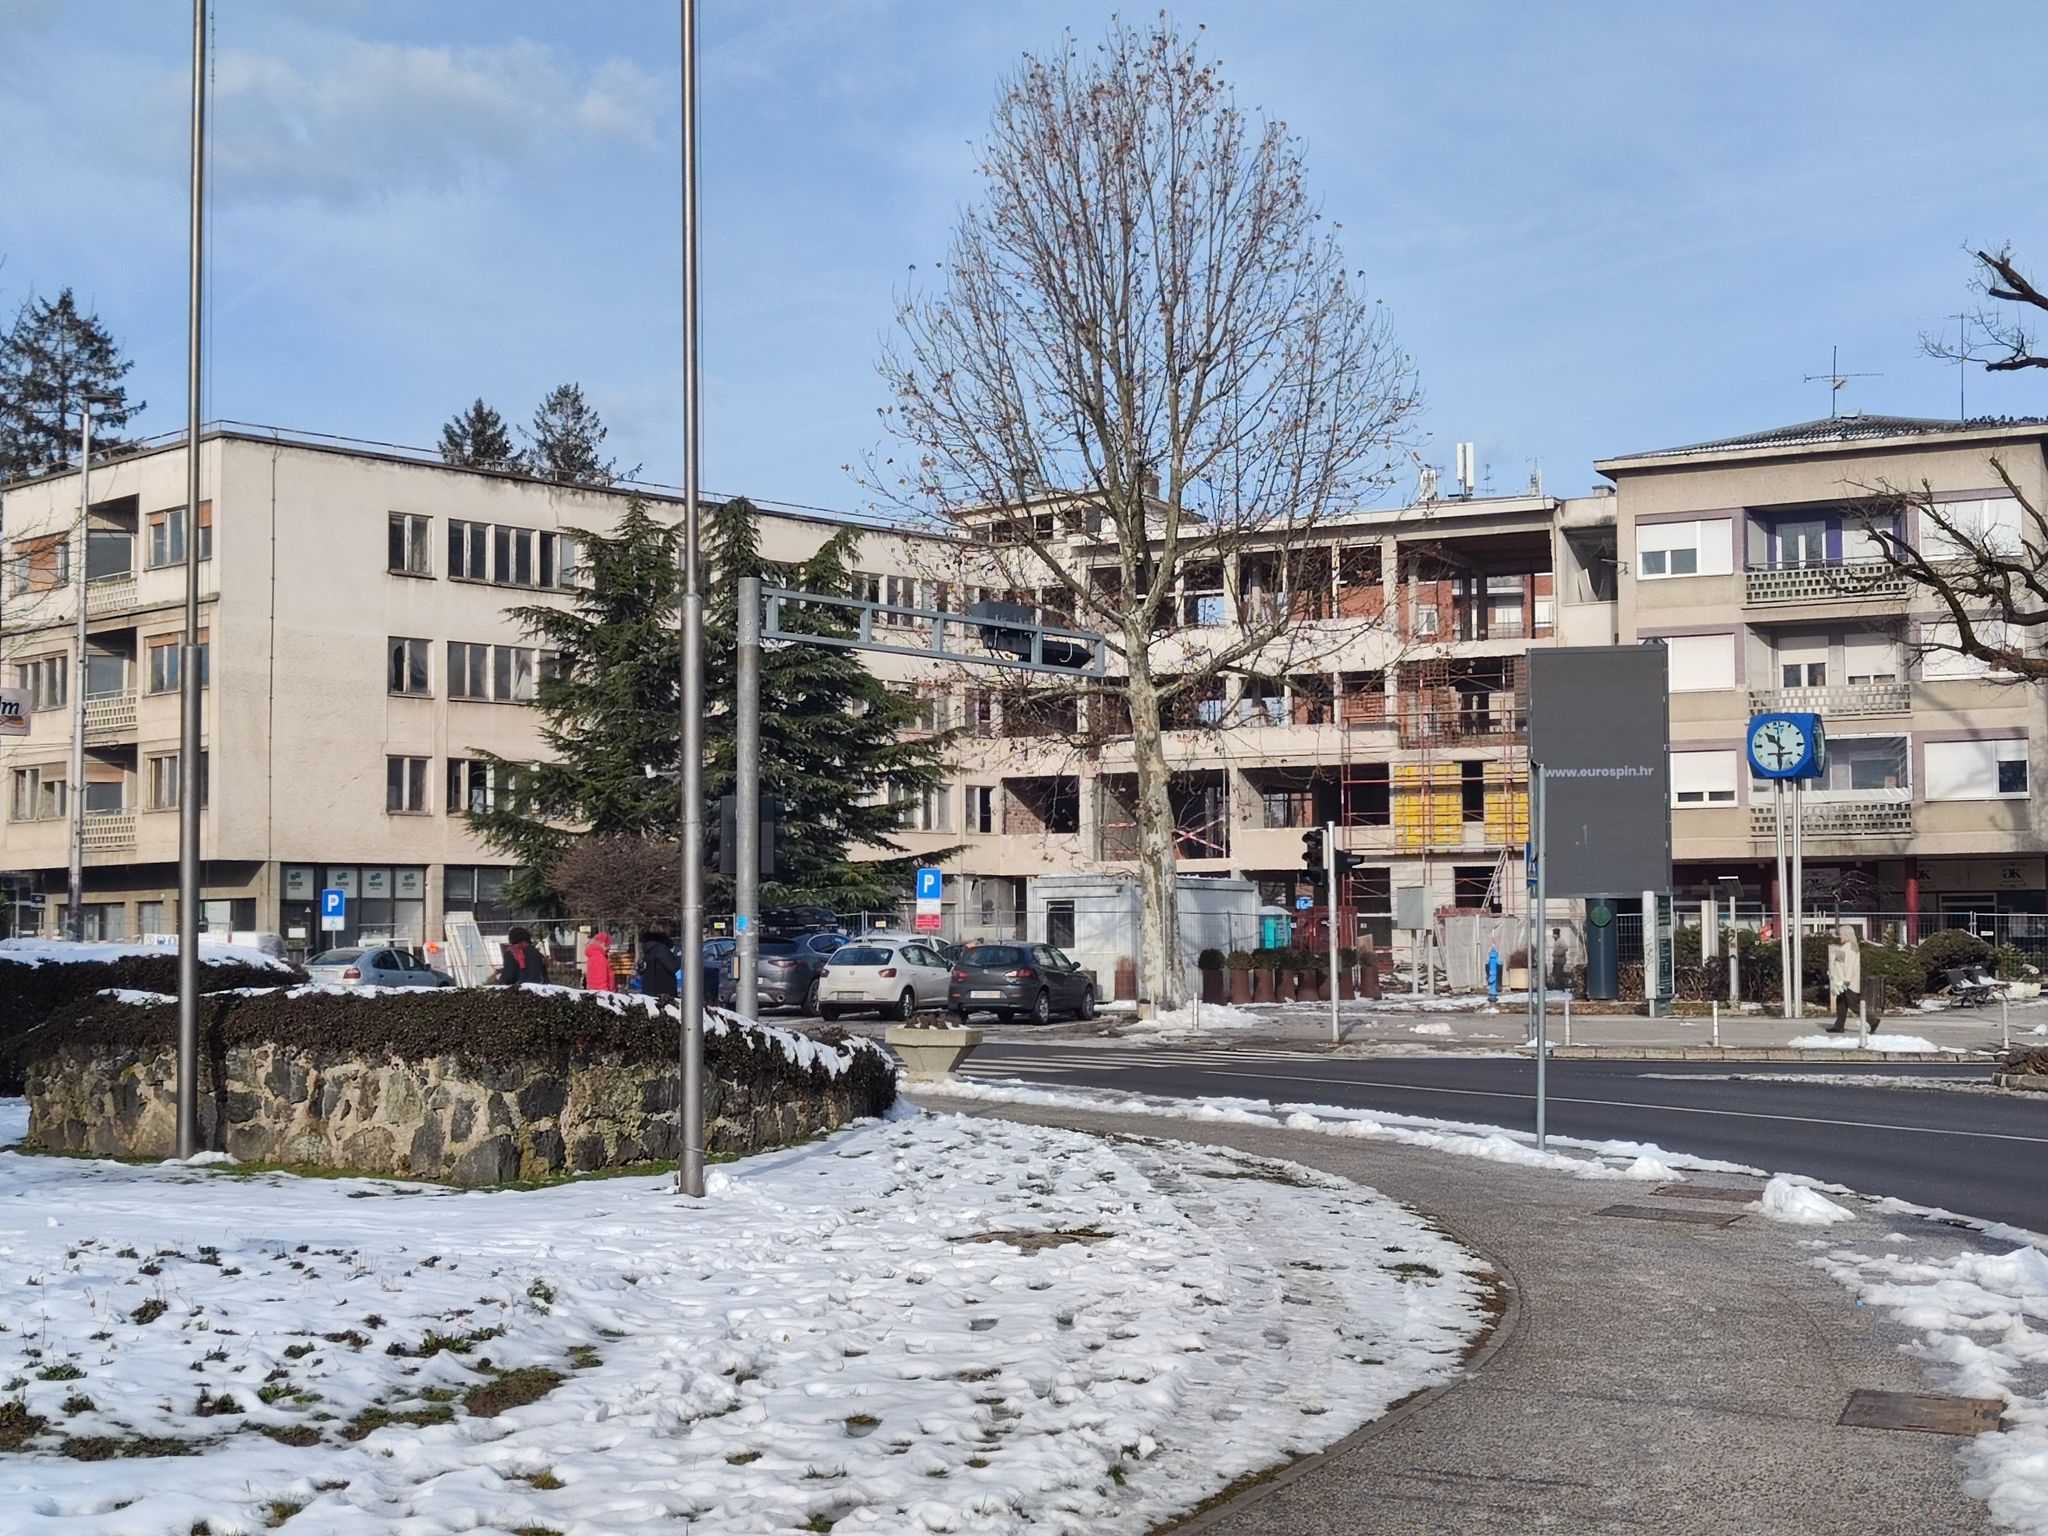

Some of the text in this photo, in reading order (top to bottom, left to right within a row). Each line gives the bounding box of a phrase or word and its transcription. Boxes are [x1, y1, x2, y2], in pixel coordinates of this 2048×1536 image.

[1545, 765, 1654, 780] www.eurospin.hr
[924, 874, 935, 894] P
[327, 894, 339, 912] P
